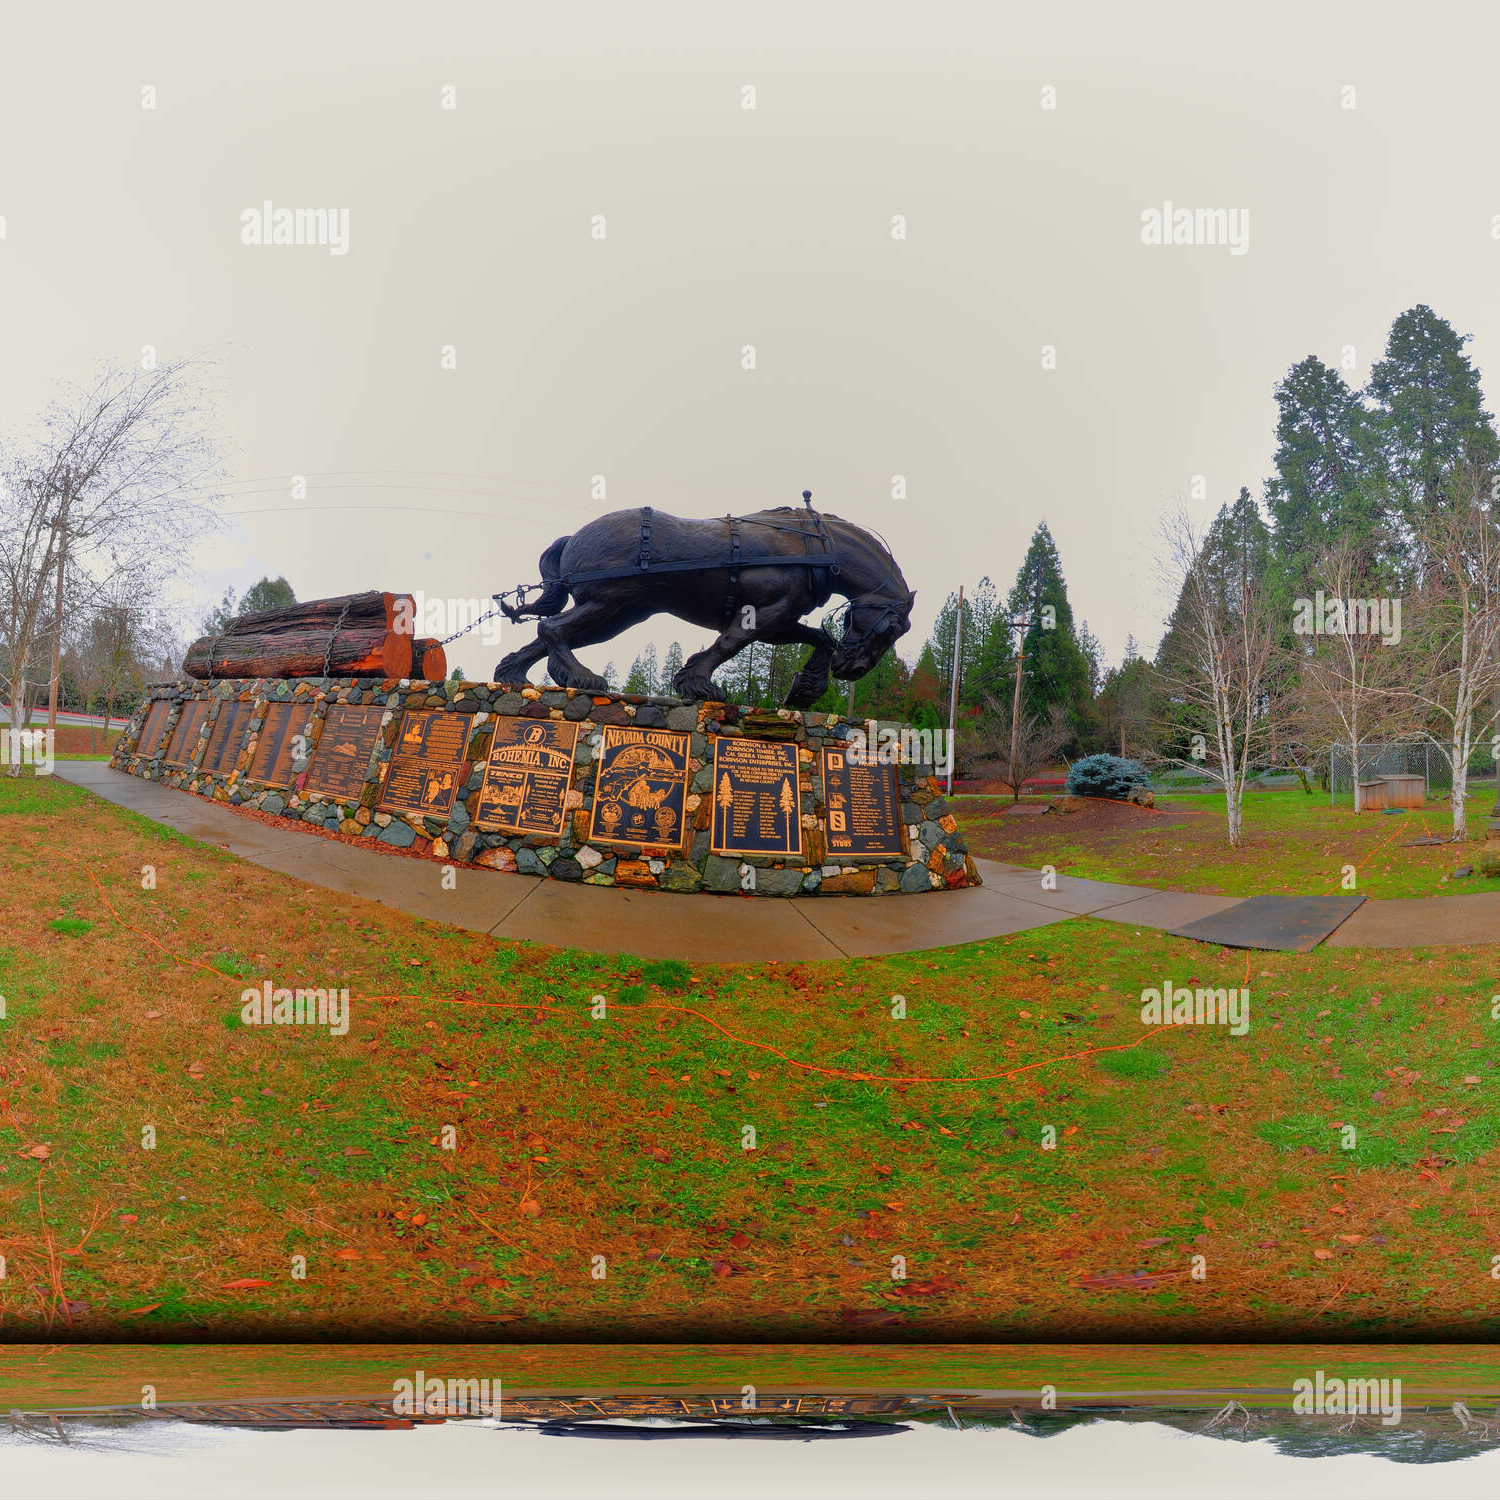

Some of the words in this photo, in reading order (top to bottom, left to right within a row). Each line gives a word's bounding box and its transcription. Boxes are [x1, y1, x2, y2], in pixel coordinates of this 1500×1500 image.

[605, 729, 645, 751] NEVADA
[646, 733, 687, 757] COUNTY
[548, 755, 569, 769] INC.
[719, 756, 748, 764] ROBINSON
